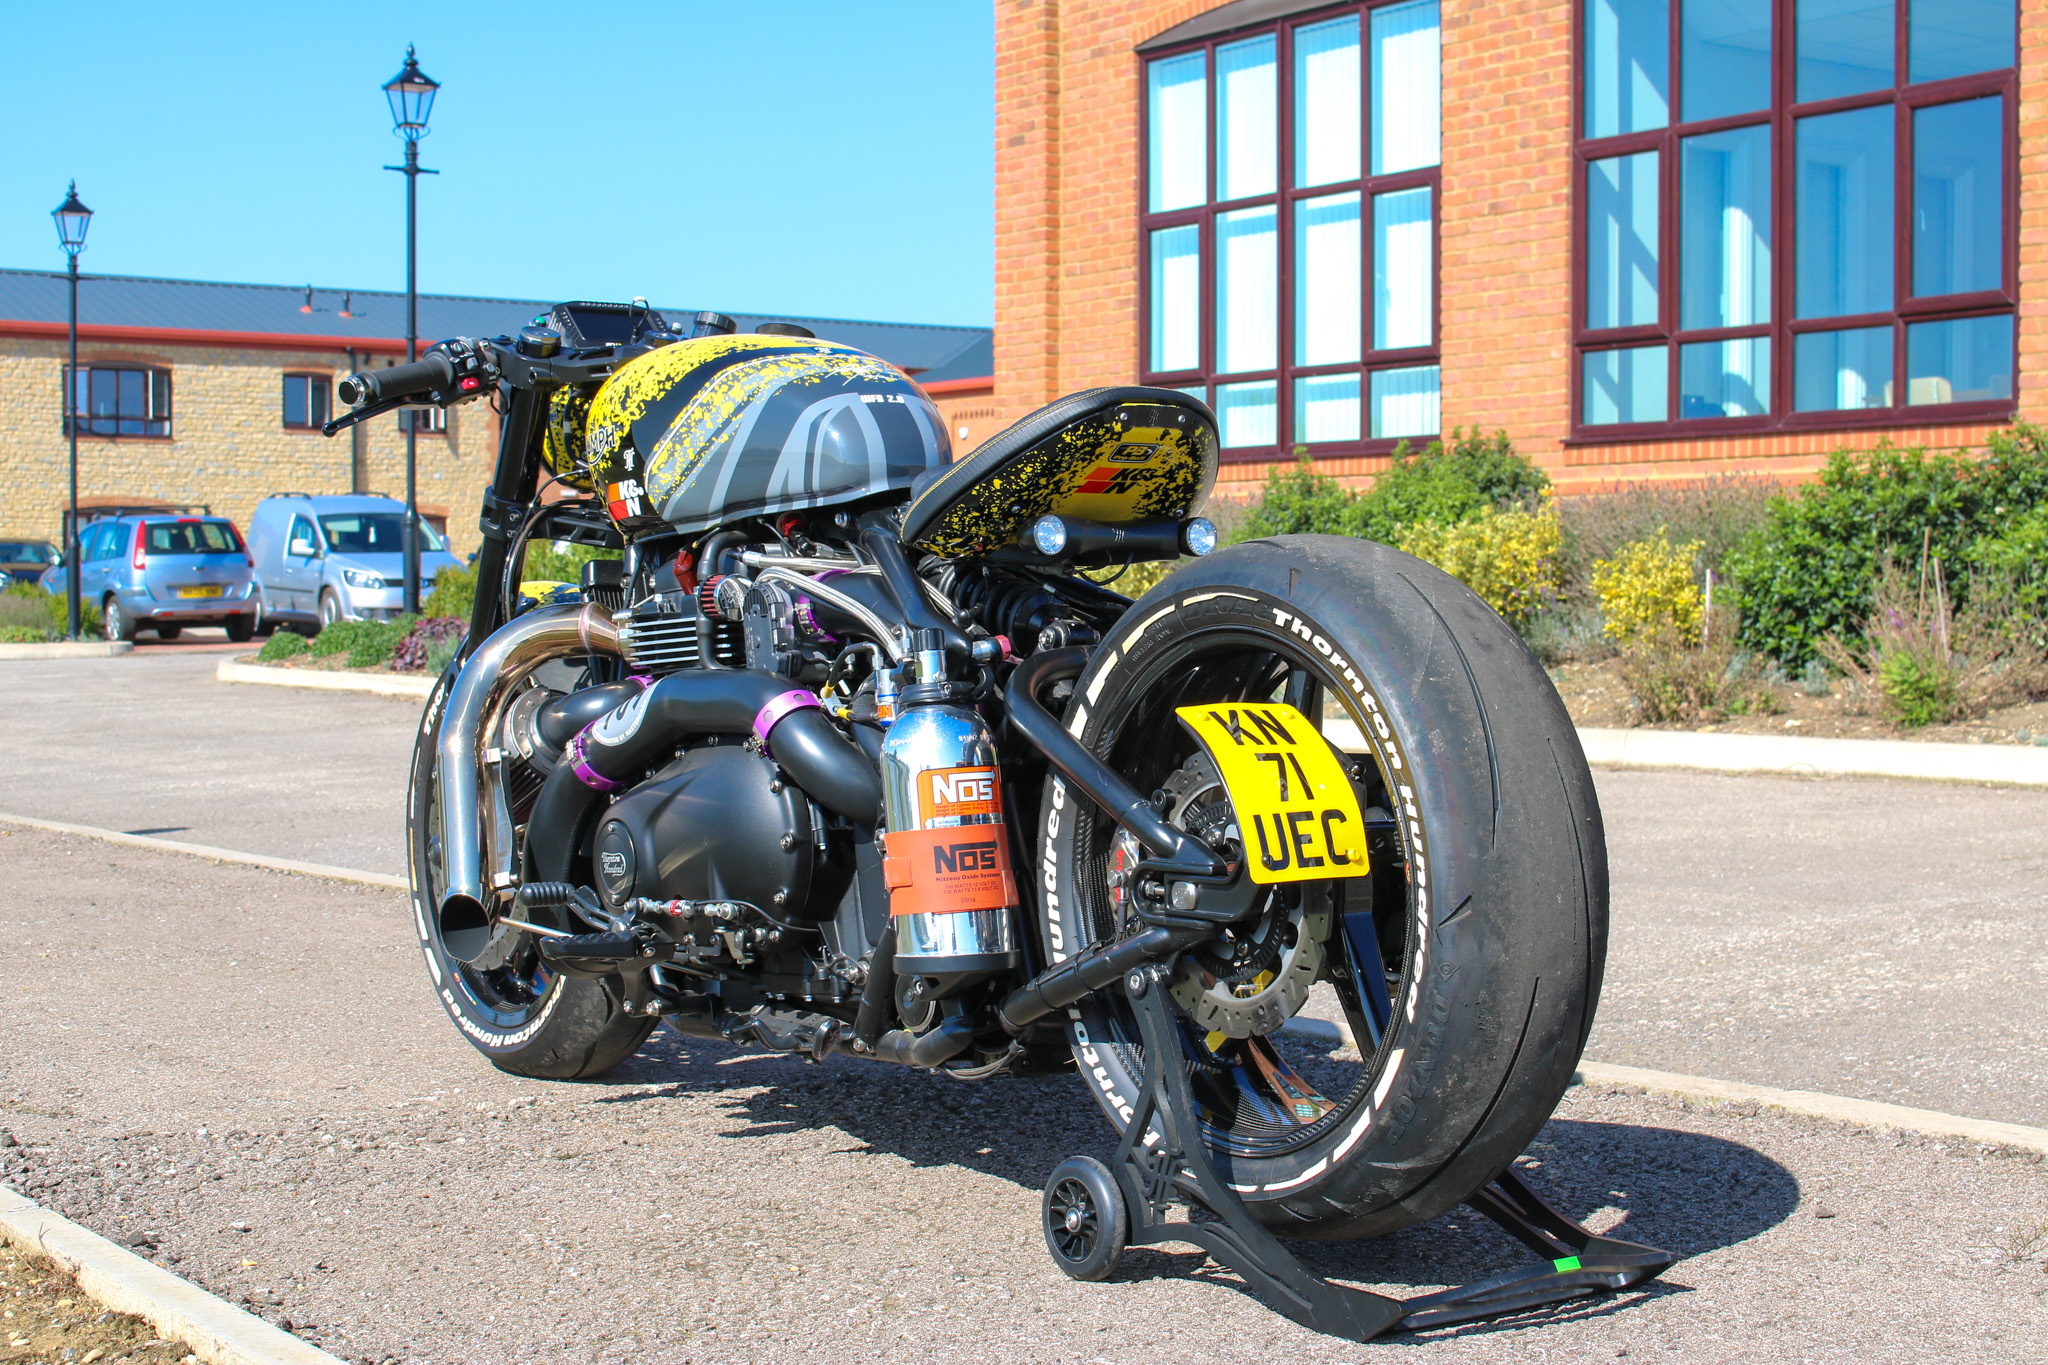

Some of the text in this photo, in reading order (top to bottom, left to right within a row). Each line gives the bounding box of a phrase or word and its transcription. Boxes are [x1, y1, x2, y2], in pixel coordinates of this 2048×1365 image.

[1208, 709, 1297, 746] KN
[931, 769, 996, 805] NOS
[1254, 752, 1315, 802] 71
[1253, 809, 1353, 871] UEC
[1271, 608, 1429, 1024] Thornton Hundred
[933, 839, 999, 874] NOS
[441, 987, 504, 1047] Hundred
[1386, 989, 1453, 1146] DUNLOP
